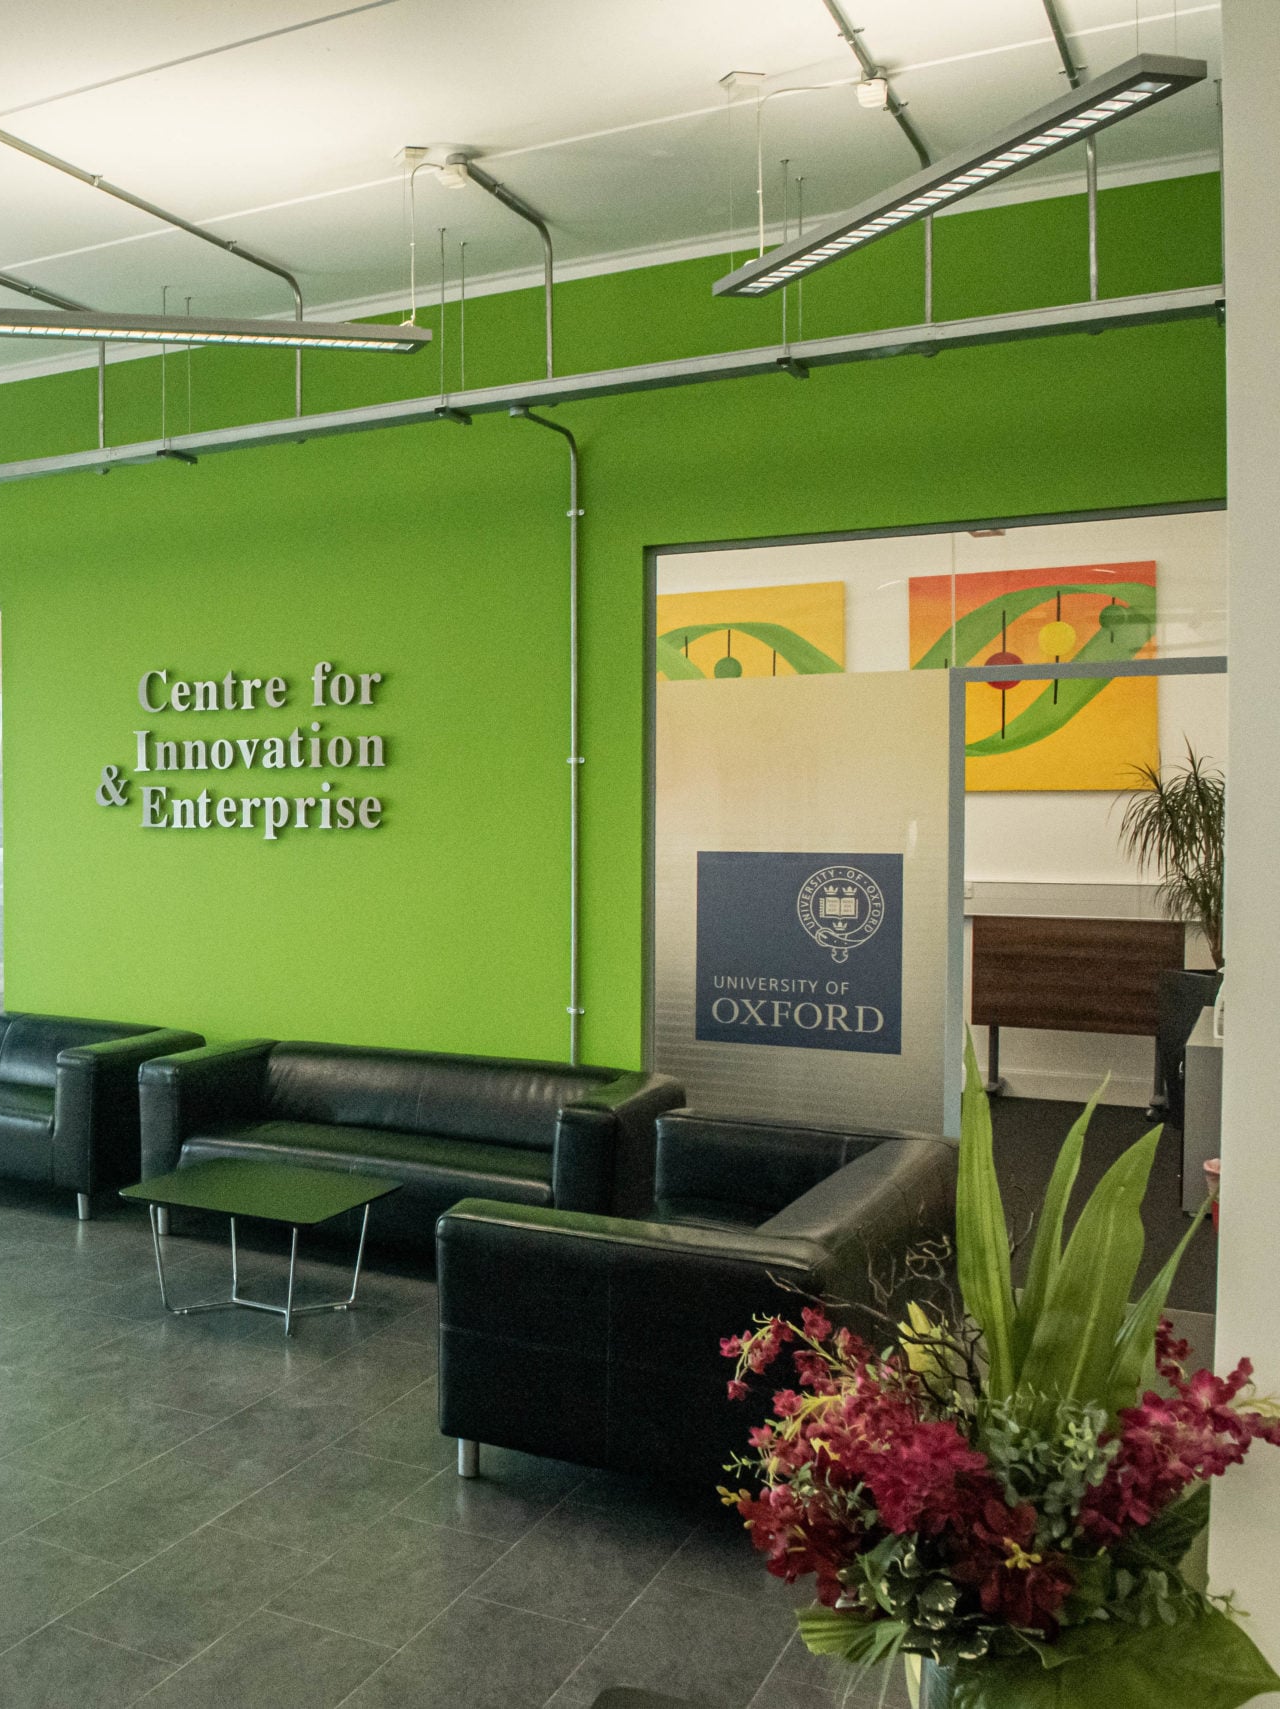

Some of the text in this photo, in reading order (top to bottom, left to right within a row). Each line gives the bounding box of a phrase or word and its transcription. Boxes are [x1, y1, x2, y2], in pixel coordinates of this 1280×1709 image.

[138, 661, 382, 713] Centre for
[133, 721, 386, 772] Innovation
[95, 764, 383, 840] & Enterprise
[800, 869, 881, 933] UNIVERSITY OF OXFORD
[713, 975, 850, 995] UNIVERSITY OF
[711, 997, 885, 1034] OXFORD
